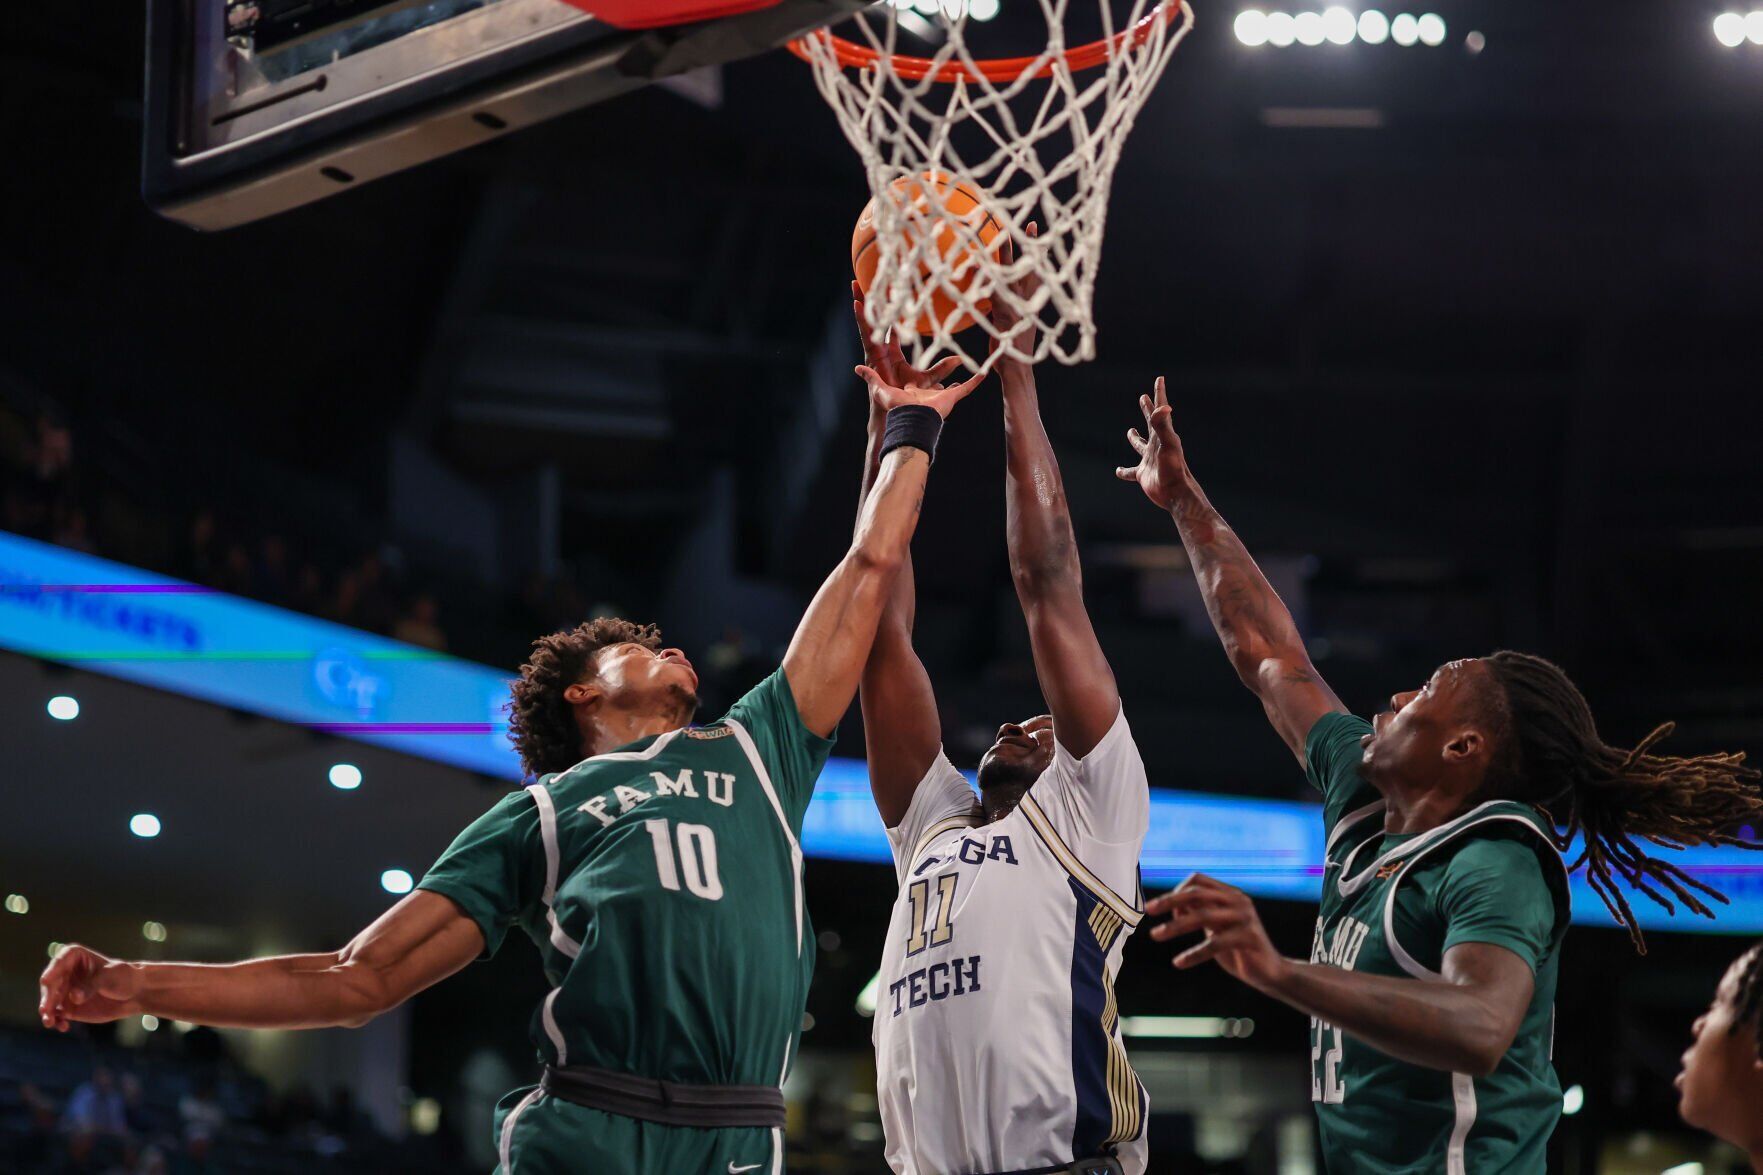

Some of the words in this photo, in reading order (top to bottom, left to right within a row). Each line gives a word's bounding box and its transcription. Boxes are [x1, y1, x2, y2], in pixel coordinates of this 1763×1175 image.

[577, 769, 736, 828] FAMU
[645, 818, 723, 901] 10
[906, 872, 960, 958] 11
[889, 955, 981, 1018] TECH
[1310, 1016, 1345, 1104] 22
